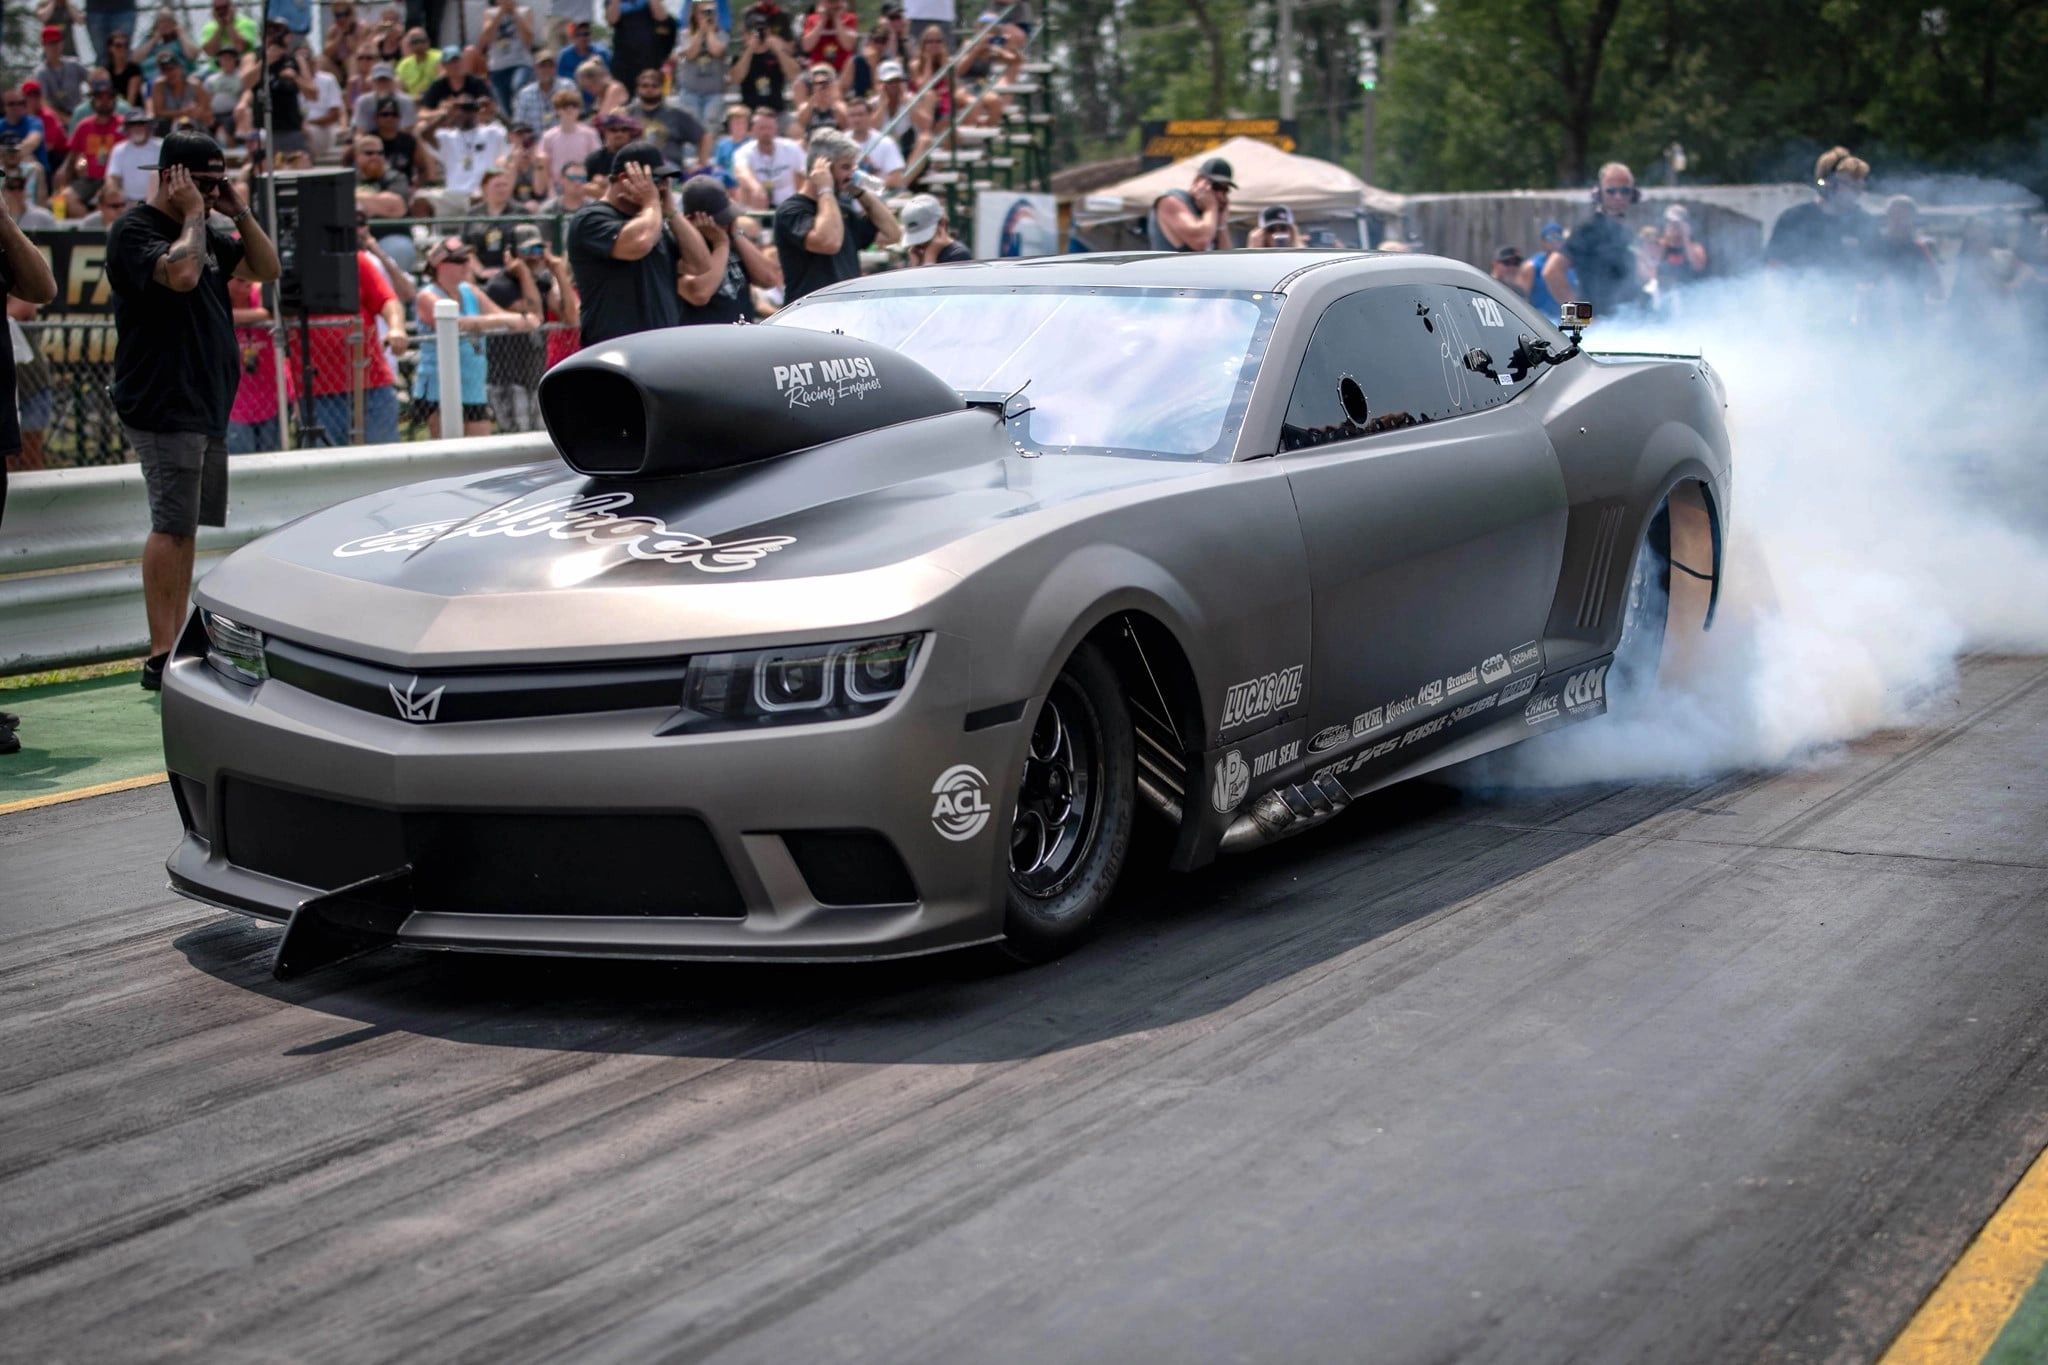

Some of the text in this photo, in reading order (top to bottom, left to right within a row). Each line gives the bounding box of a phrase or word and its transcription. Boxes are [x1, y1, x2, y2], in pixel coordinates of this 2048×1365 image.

[1472, 297, 1504, 327] 120
[773, 357, 876, 390] PAT MUSI
[784, 376, 881, 408] Racing Engines
[1418, 679, 1442, 704] MSD
[1446, 666, 1477, 690] Browell
[1222, 666, 1303, 728] LUCAS OIL
[1385, 694, 1415, 724] Hoosier
[1525, 693, 1560, 717] CHANCE
[1399, 714, 1449, 748] PENSKE
[1253, 740, 1301, 778] TOTAL SEAL
[1214, 750, 1242, 811] VP
[931, 789, 991, 818] ACL
